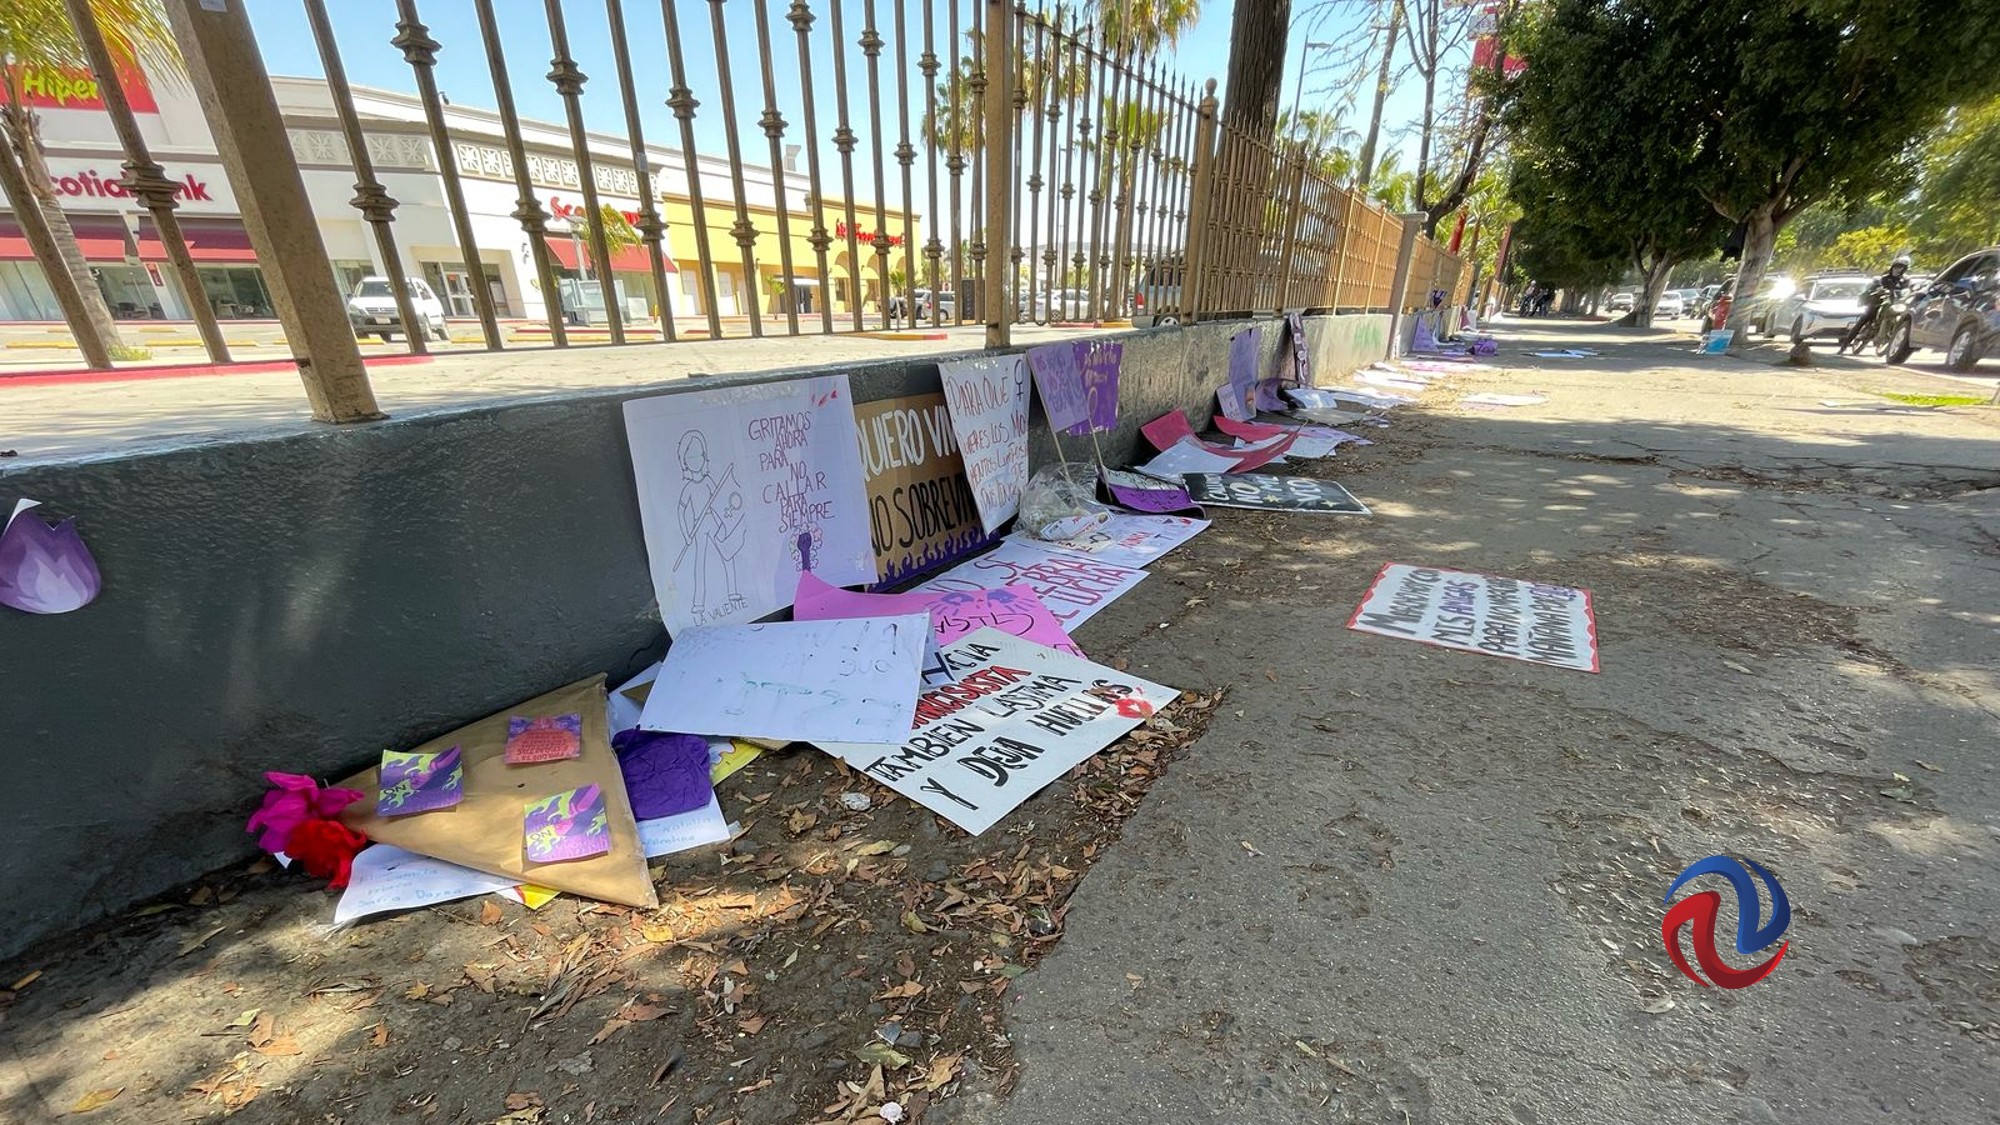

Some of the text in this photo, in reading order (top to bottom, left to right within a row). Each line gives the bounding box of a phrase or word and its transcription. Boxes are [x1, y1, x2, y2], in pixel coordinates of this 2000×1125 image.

[748, 411, 812, 441] GRITAMOS
[774, 429, 808, 452] AHORA
[760, 448, 789, 472] PARA
[790, 460, 807, 481] NO
[763, 471, 828, 504] CALLAR
[779, 500, 836, 533] SIEMPRE
[780, 493, 808, 518] PARA
[694, 598, 750, 627] LA VALIENTE
[1486, 604, 1520, 623] NO
[1430, 613, 1475, 645] MIS
[1478, 621, 1521, 655] PARA
[1526, 610, 1579, 668] MAÑANA
[864, 674, 1082, 782] TAMBIEN LASTIMA
[920, 679, 1134, 811] Y DEJA HUELLAS
